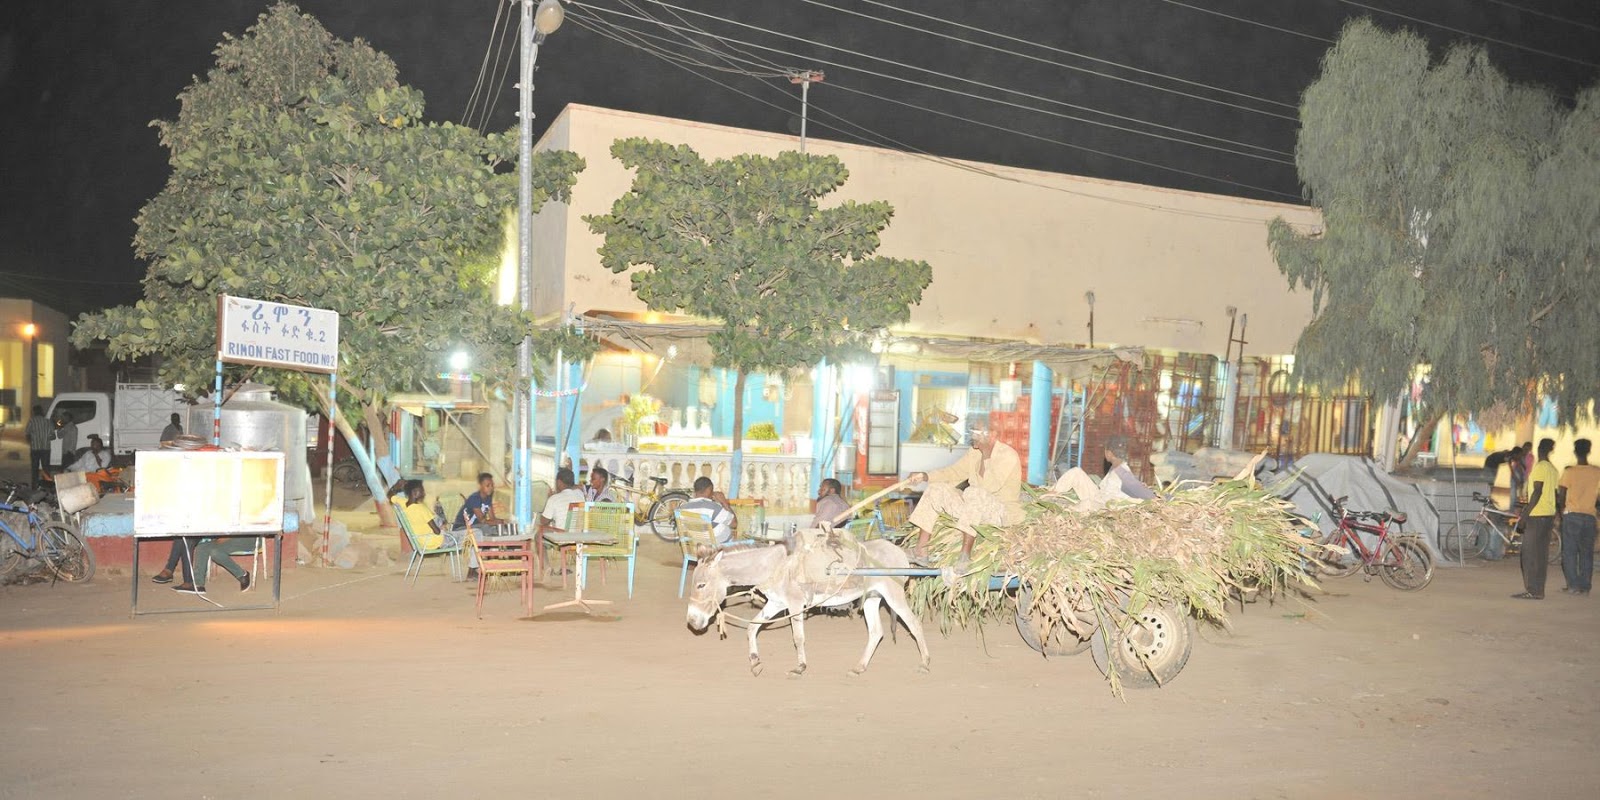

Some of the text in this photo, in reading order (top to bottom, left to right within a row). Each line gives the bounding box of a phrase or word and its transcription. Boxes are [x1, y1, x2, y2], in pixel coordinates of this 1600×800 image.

[228, 342, 262, 358] RIMON
[265, 346, 291, 361] FAST
[293, 350, 319, 364] FOOD
